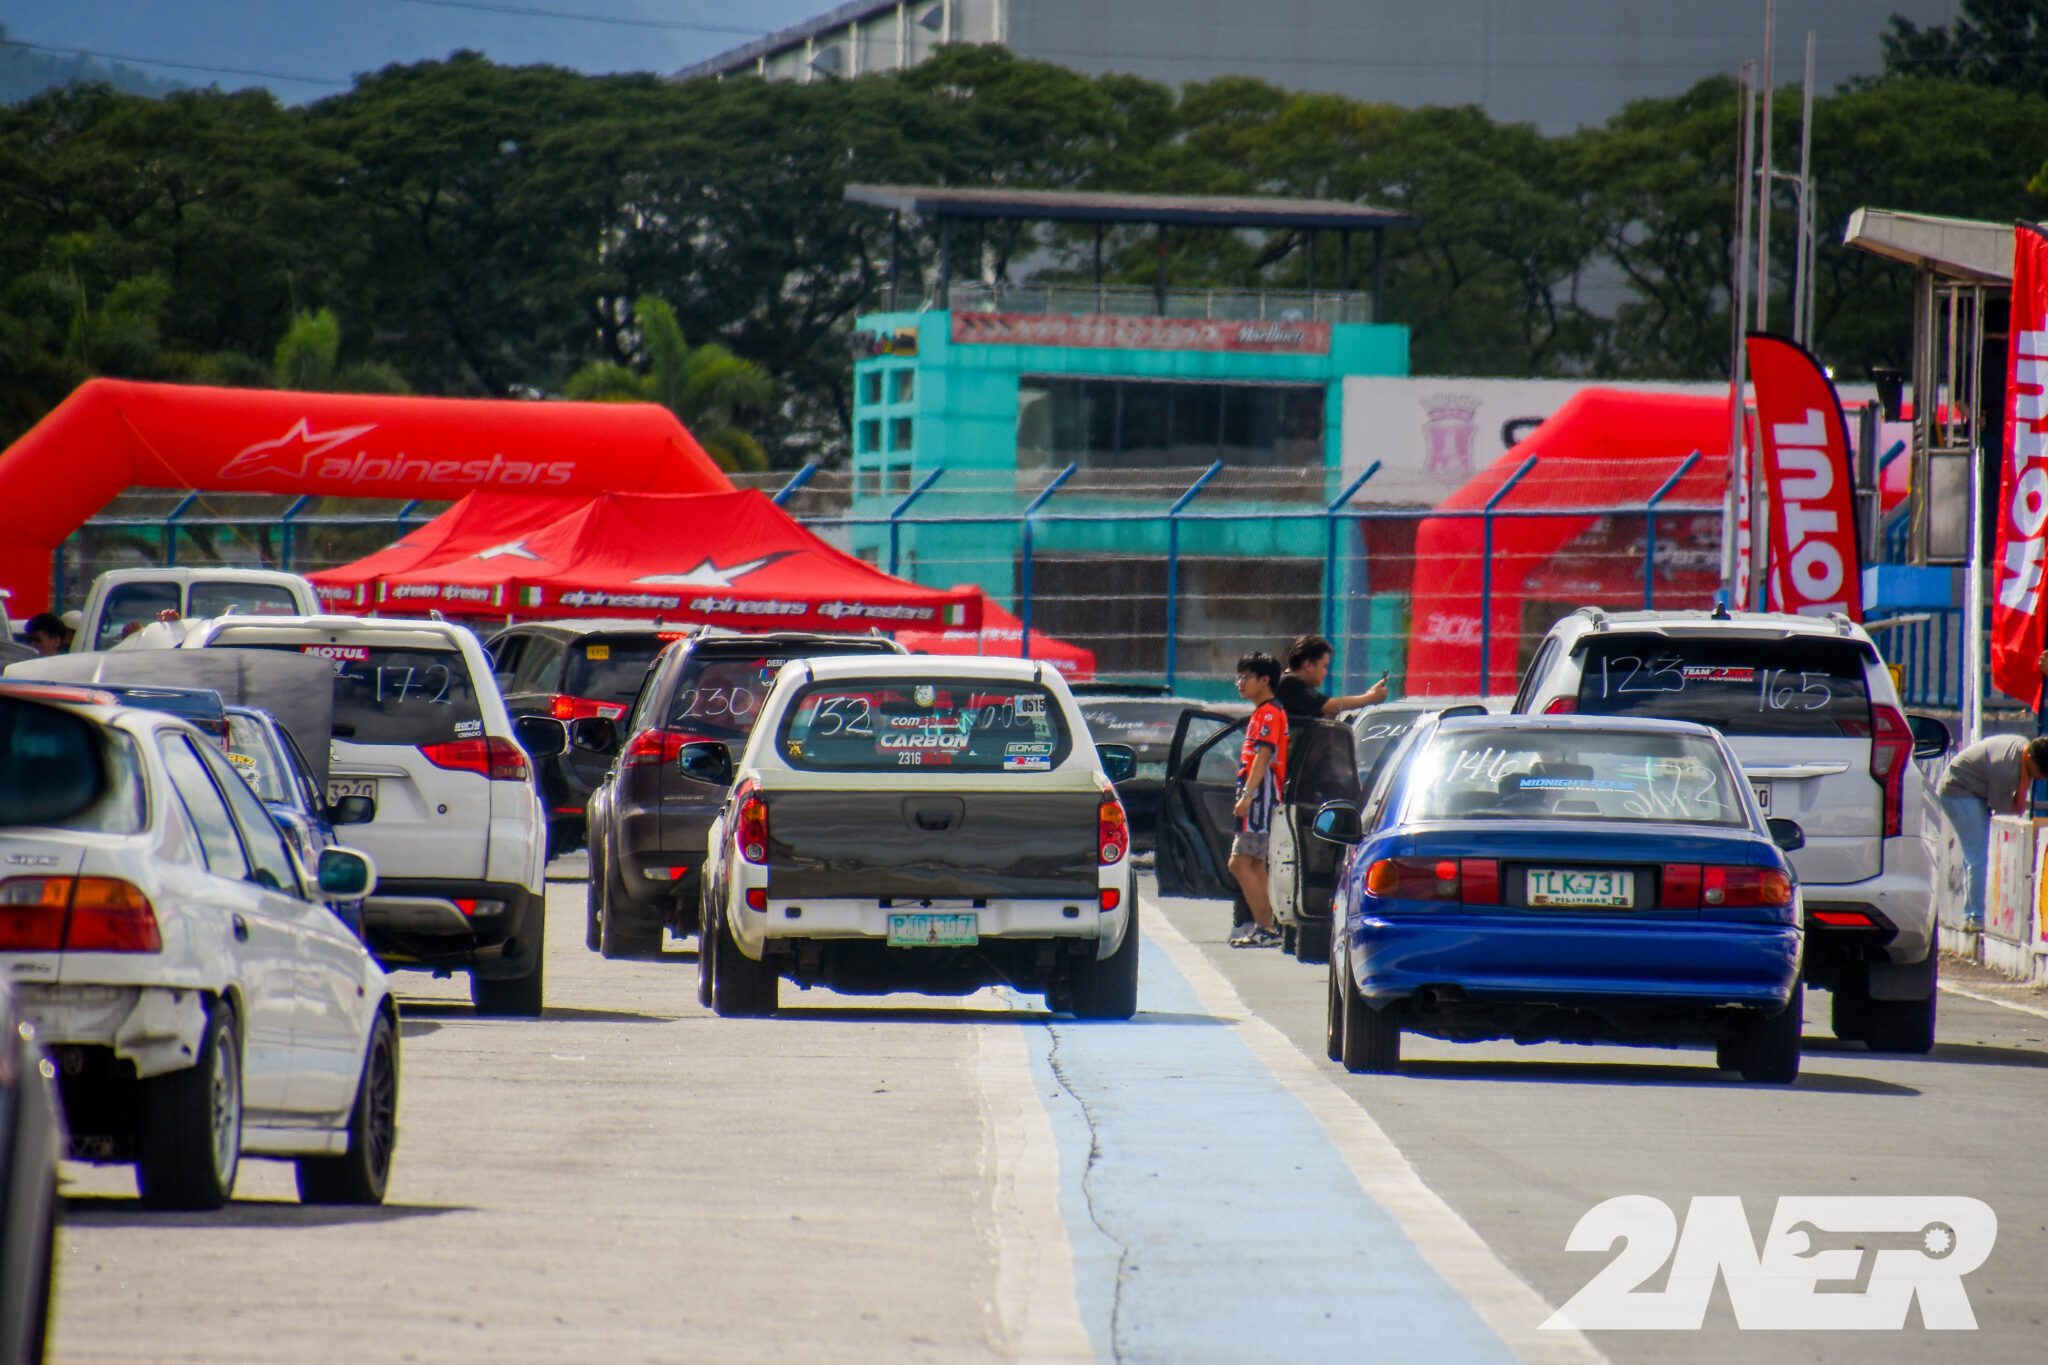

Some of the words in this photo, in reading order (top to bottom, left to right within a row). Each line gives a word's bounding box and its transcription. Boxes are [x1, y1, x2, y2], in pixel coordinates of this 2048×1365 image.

[318, 451, 576, 485] alpinestars
[303, 647, 366, 660] MOTUL
[1603, 656, 1685, 698] 123
[677, 687, 754, 720] 230
[880, 734, 969, 748] CARBON
[898, 752, 922, 765] 2316
